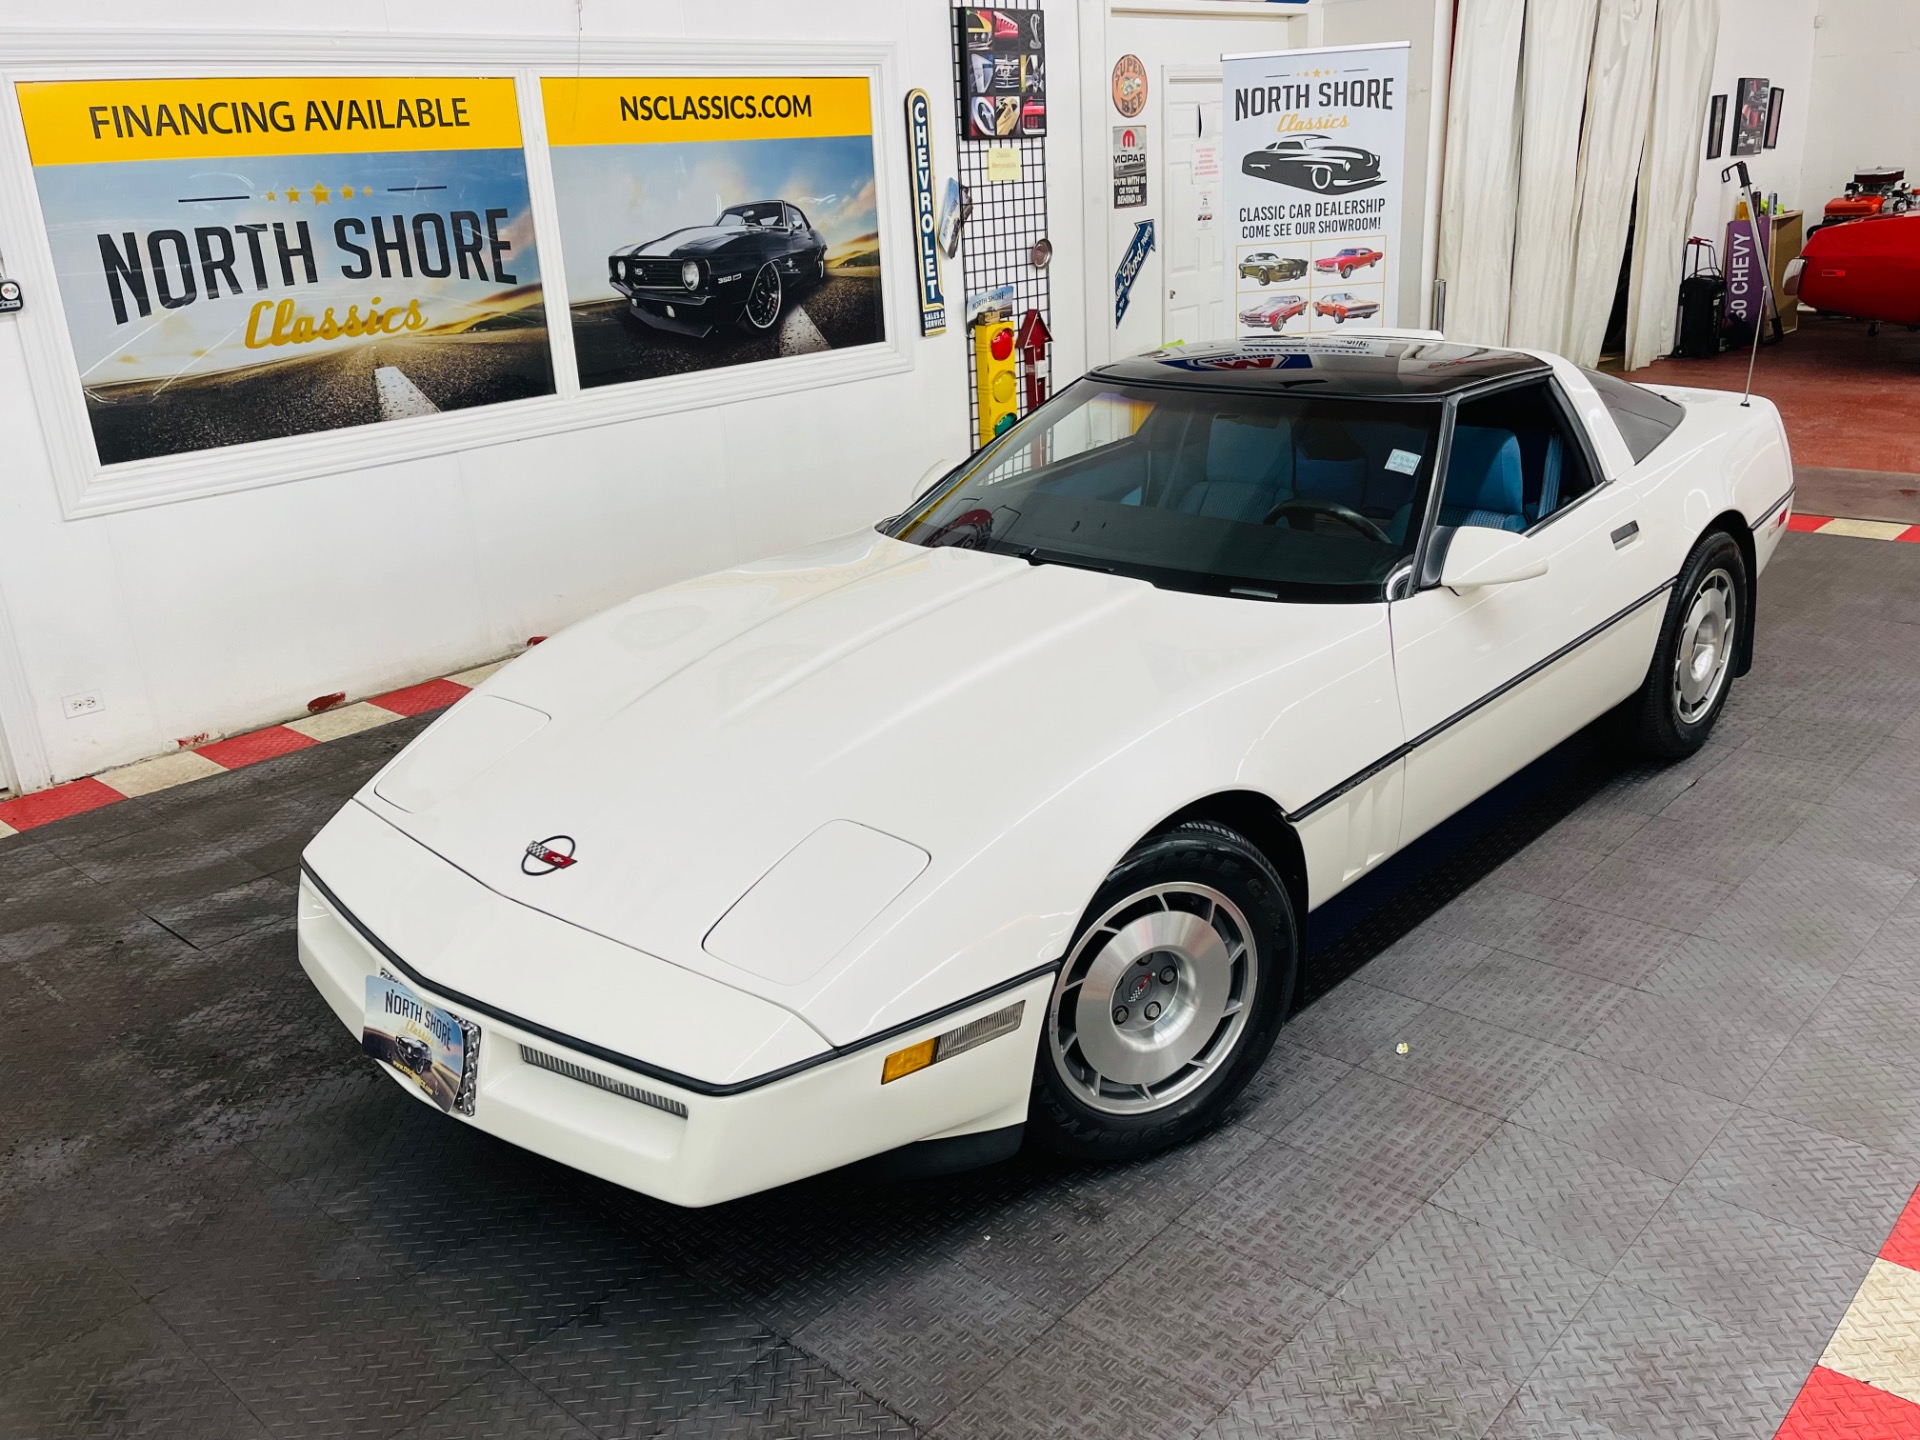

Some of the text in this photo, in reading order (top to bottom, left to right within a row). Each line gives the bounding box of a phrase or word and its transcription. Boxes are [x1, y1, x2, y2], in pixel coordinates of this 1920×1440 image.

[620, 95, 812, 121] NSCLASSICS.COM
[1120, 91, 1143, 114] BEE
[1235, 77, 1394, 121] NORTH SHORE
[88, 97, 471, 139] FINANCING AVAILABLE
[1276, 113, 1351, 133] Classics
[1113, 153, 1146, 164] MOPAR
[1127, 175, 1140, 186] WITH
[914, 102, 938, 299] CHEVROLET
[1117, 194, 1142, 205] BEHIND US
[1239, 198, 1386, 222] CLASSIC CAR DEALERSHIP
[1241, 216, 1381, 239] COME SEE OUR SHOWROOM!
[97, 208, 518, 326] NORTH SHORE
[1122, 242, 1145, 287] Ford
[1140, 226, 1152, 246] PARTS
[1731, 233, 1751, 294] CHEVY
[244, 296, 430, 350] Classics
[924, 311, 940, 321] SALES
[925, 318, 946, 329] SERVICE
[385, 989, 451, 1051] NORTH SHORE
[405, 1019, 435, 1047] Classics
